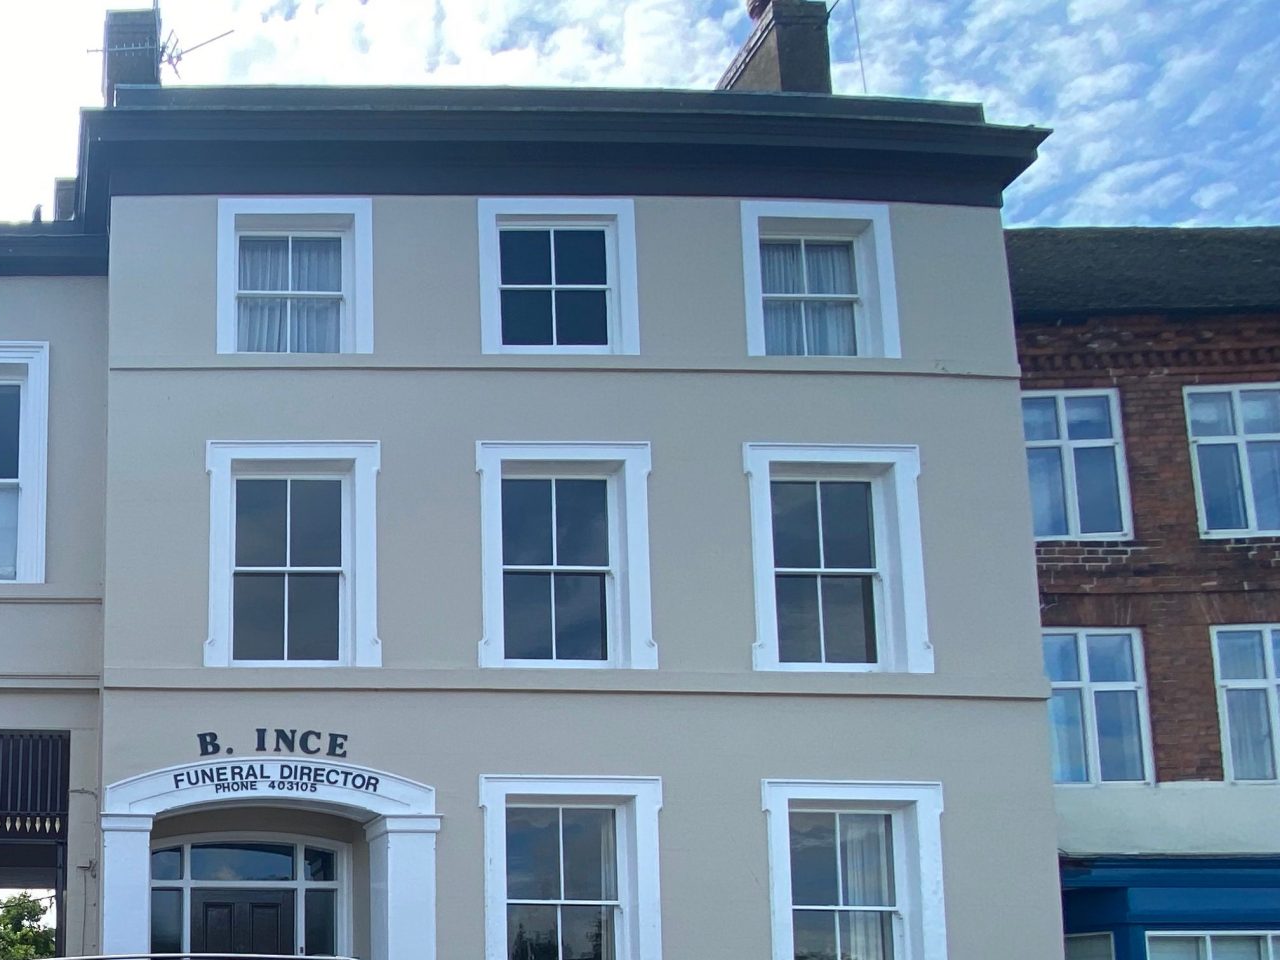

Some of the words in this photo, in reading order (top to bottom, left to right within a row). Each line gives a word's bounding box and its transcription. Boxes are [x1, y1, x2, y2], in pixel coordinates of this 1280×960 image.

[196, 731, 234, 757] B.
[255, 728, 348, 758] INCE
[173, 763, 271, 789] FUNERAL
[279, 764, 380, 793] DIRECTOR
[215, 781, 257, 793] PHONE
[268, 781, 317, 792] 403105
